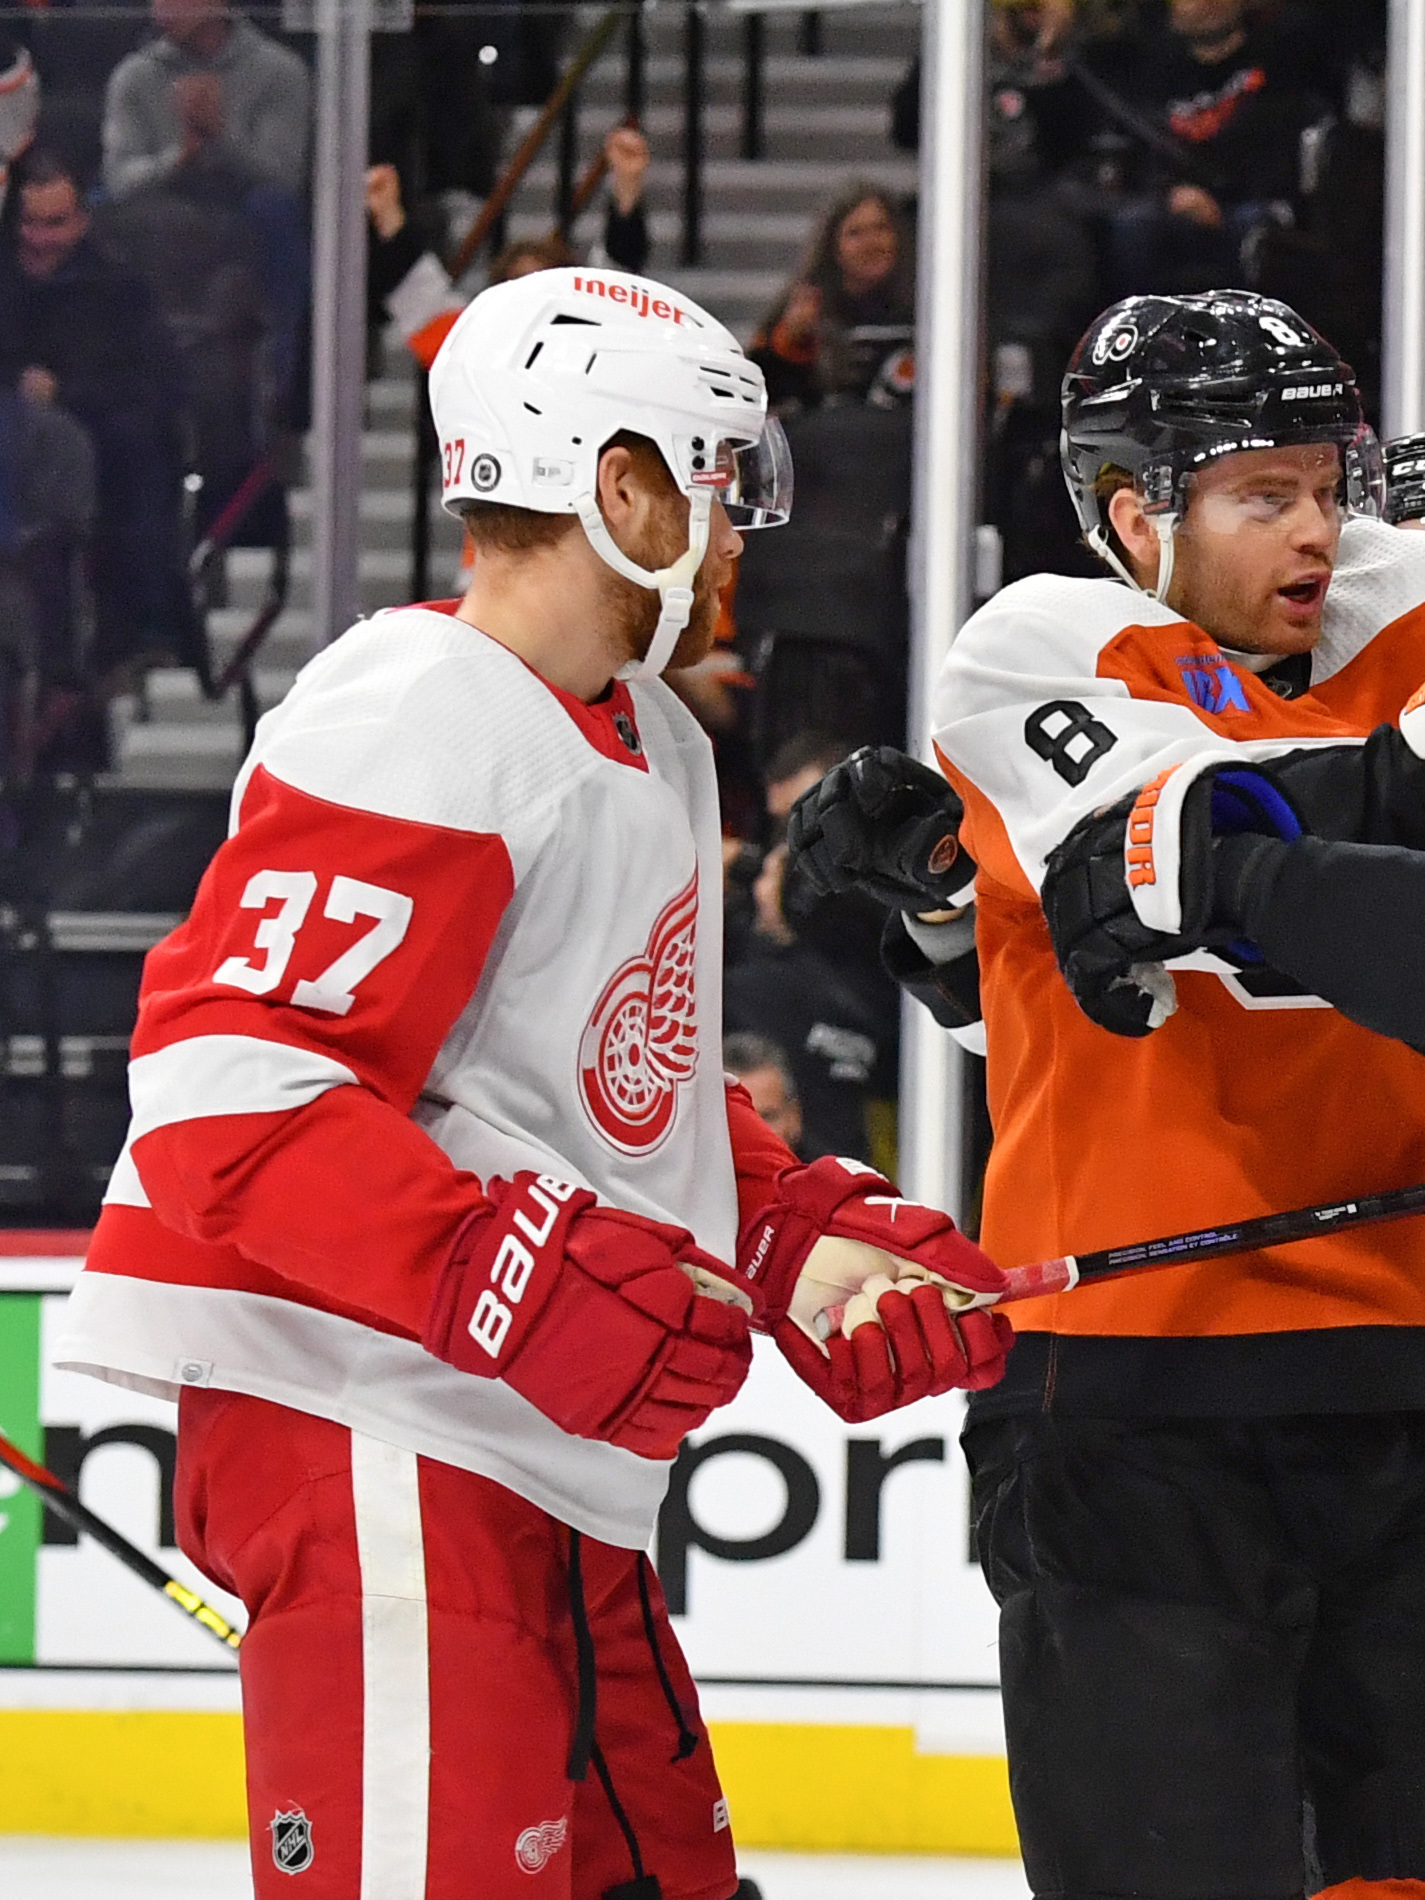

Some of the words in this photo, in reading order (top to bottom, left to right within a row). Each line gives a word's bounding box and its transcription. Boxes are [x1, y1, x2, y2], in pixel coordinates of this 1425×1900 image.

[573, 276, 685, 325] meijer
[1258, 316, 1306, 348] 8
[1281, 383, 1344, 401] BAUER
[444, 438, 465, 488] 37
[1024, 700, 1118, 788] 8
[212, 869, 414, 1016] 37
